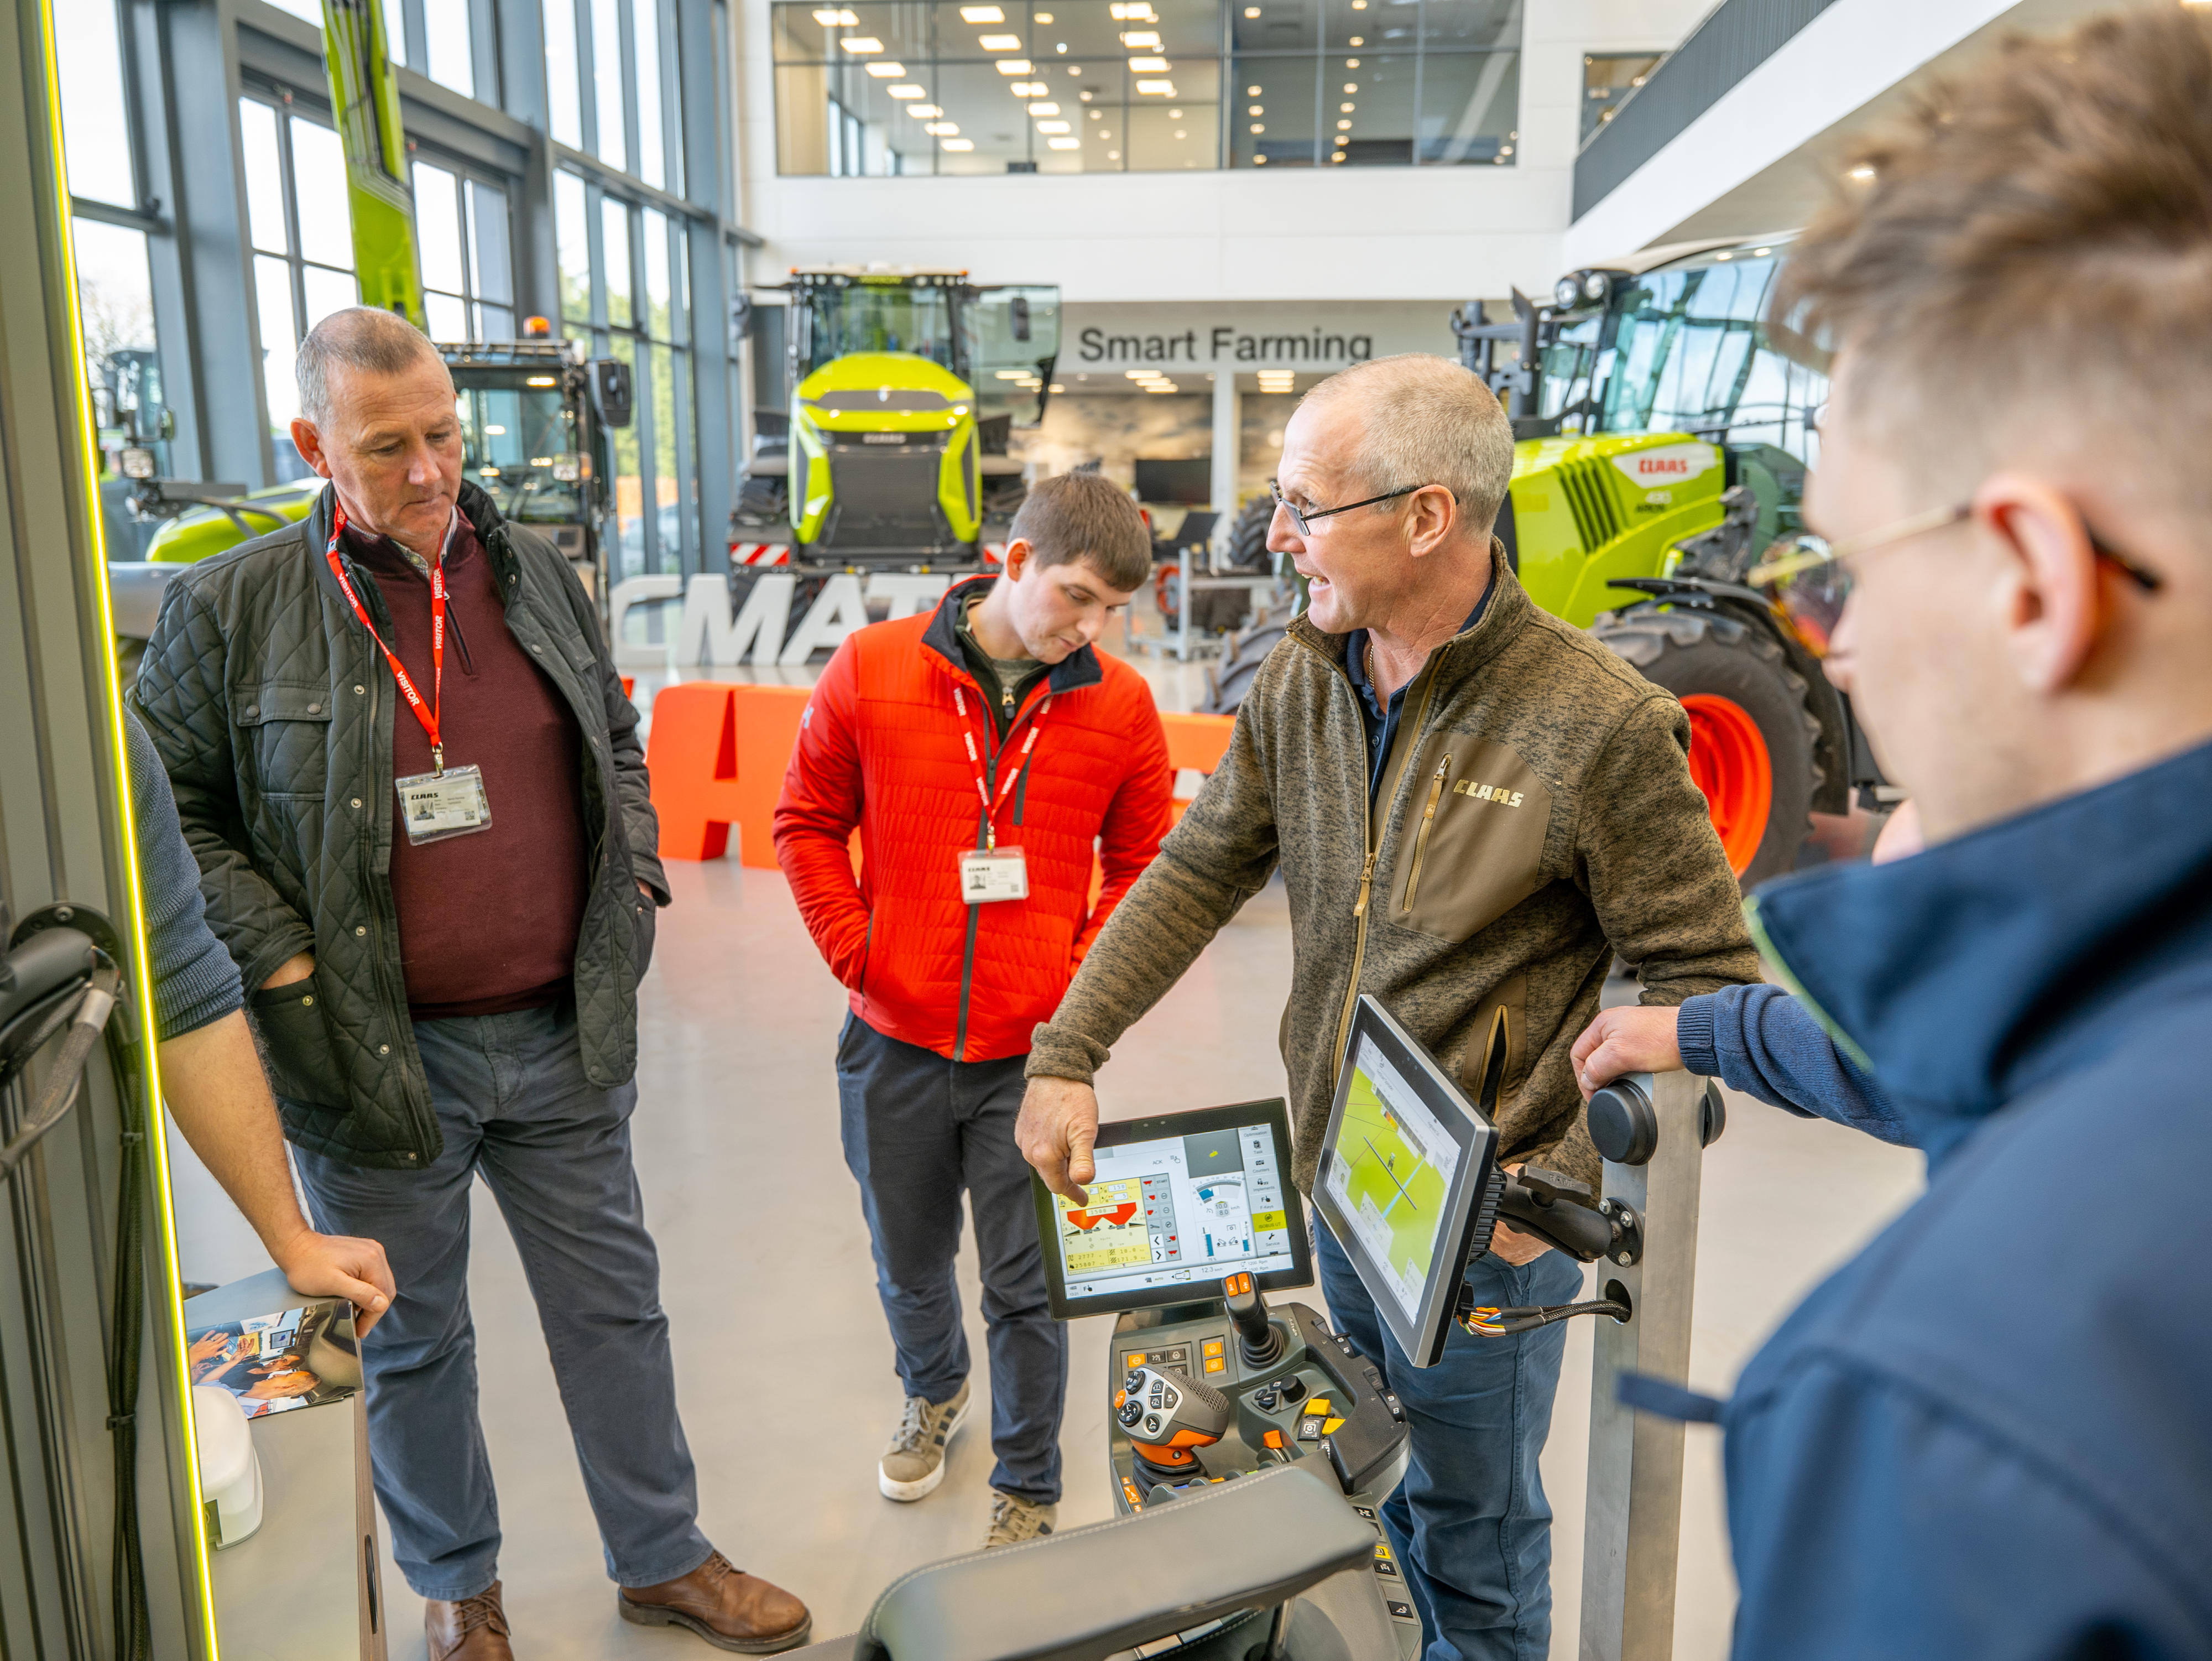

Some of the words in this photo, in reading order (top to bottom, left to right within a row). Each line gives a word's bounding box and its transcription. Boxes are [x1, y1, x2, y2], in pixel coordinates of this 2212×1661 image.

[1079, 327, 1198, 362] Smart
[1211, 326, 1373, 366] Farming
[1639, 459, 1688, 474] CLAAS
[338, 572, 358, 608] VISITOR
[434, 568, 443, 599] VISITOR
[610, 572, 982, 665] CMAT
[397, 670, 420, 706] VISITOR
[953, 687, 967, 717] VISITOR
[964, 731, 978, 762] VISITOR
[1021, 727, 1040, 753] VISITOR
[411, 792, 439, 800] CLAAS
[976, 776, 989, 806] VISITOR
[1001, 768, 1020, 795] VISITOR
[1453, 779, 1525, 808] CLAAS
